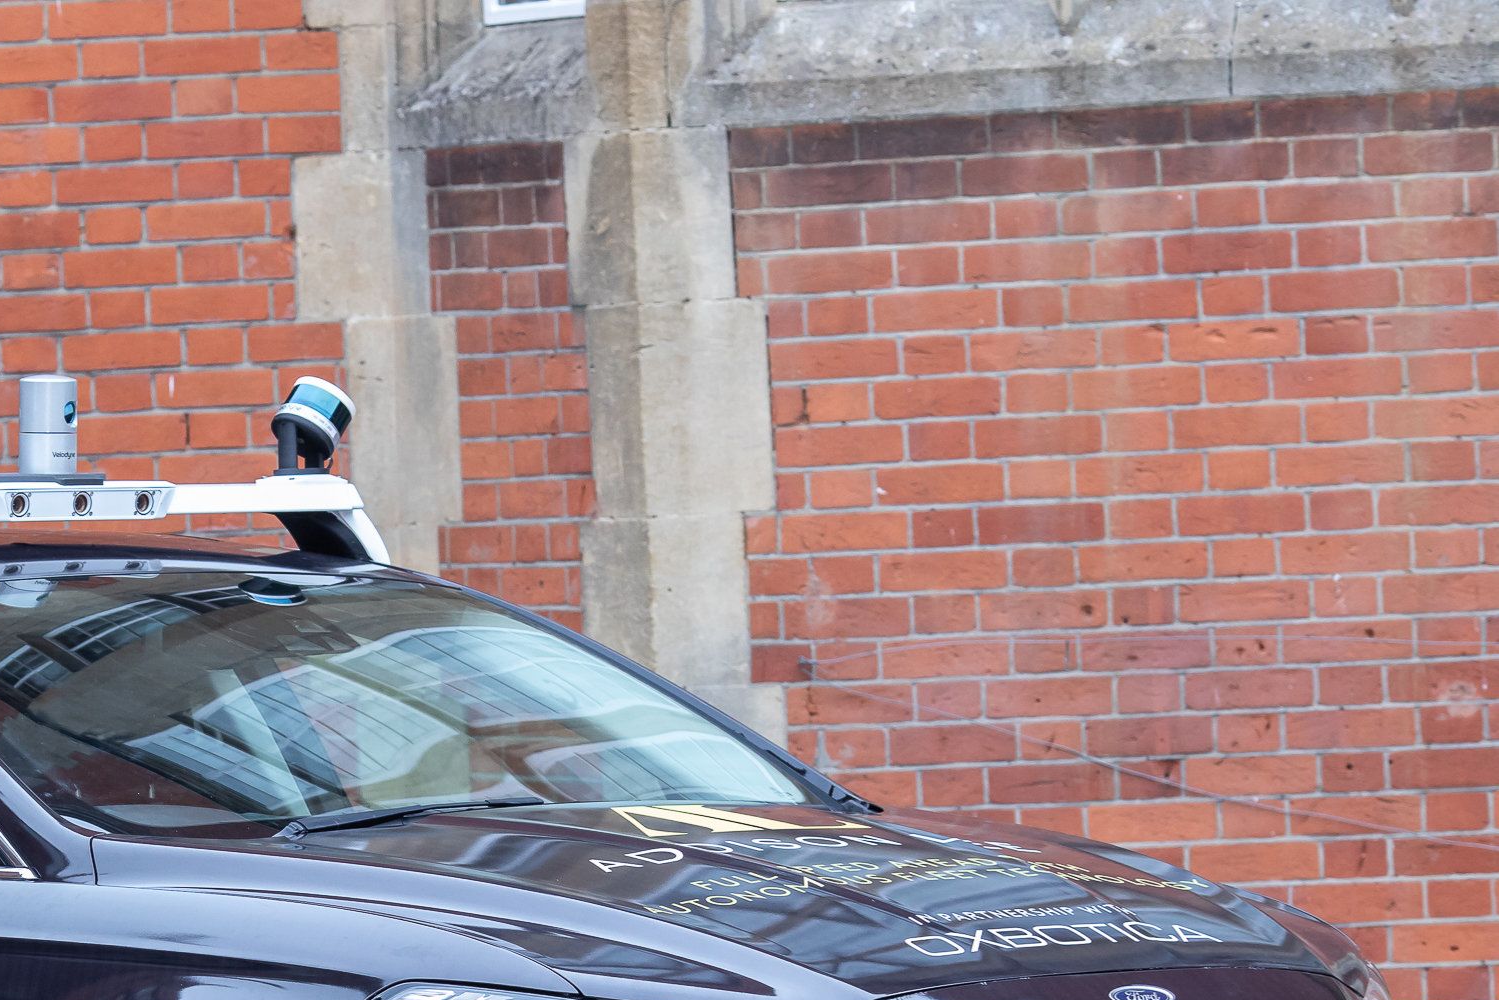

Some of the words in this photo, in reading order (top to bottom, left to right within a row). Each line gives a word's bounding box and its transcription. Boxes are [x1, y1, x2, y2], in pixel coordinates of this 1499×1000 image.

[589, 832, 902, 874] ADDISON
[691, 871, 779, 891] FULL
[888, 856, 998, 870] AHEAD
[643, 873, 893, 915] AUTONOMOUS
[892, 869, 988, 882] FLEET
[908, 913, 939, 926] IN
[937, 905, 1075, 923] PARTNERSHIP
[1077, 903, 1137, 916] WITH
[904, 921, 1224, 957] OXBOTICA
